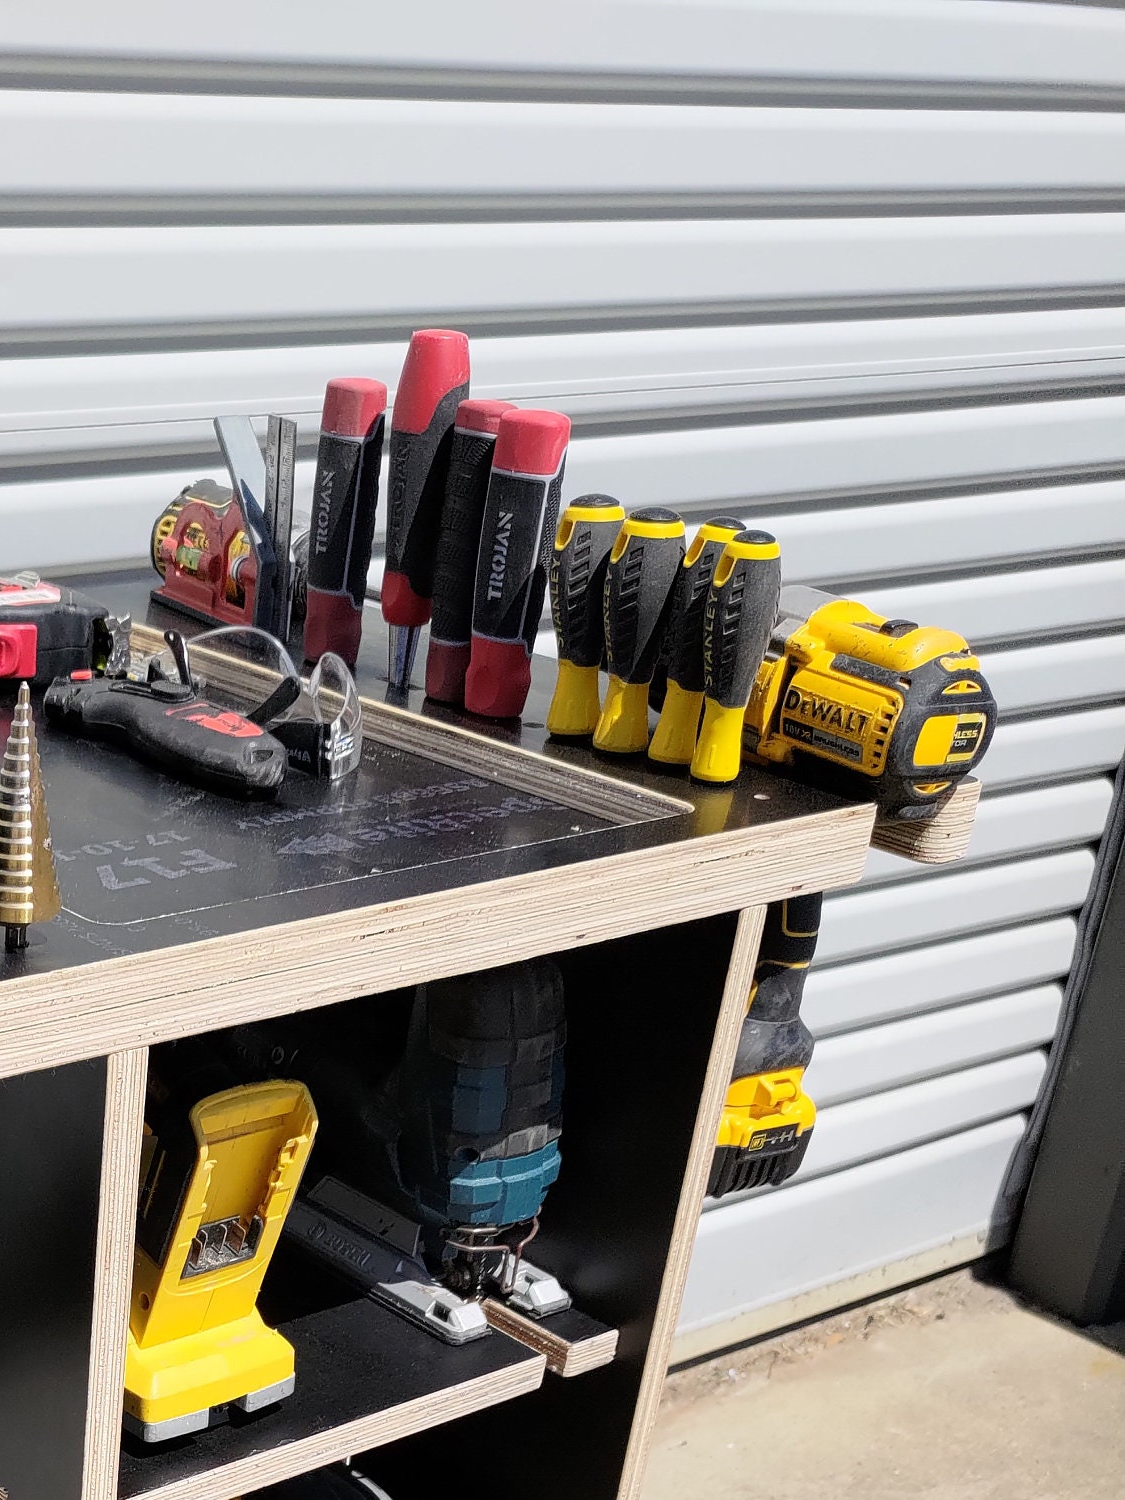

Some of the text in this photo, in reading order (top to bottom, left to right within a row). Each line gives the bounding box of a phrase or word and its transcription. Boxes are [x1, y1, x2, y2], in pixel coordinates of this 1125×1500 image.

[315, 469, 336, 556] TROJAN
[486, 510, 514, 601] TROJAN
[550, 557, 565, 648] STANLEY
[703, 589, 719, 688] STANLEY
[95, 849, 238, 892] F17
